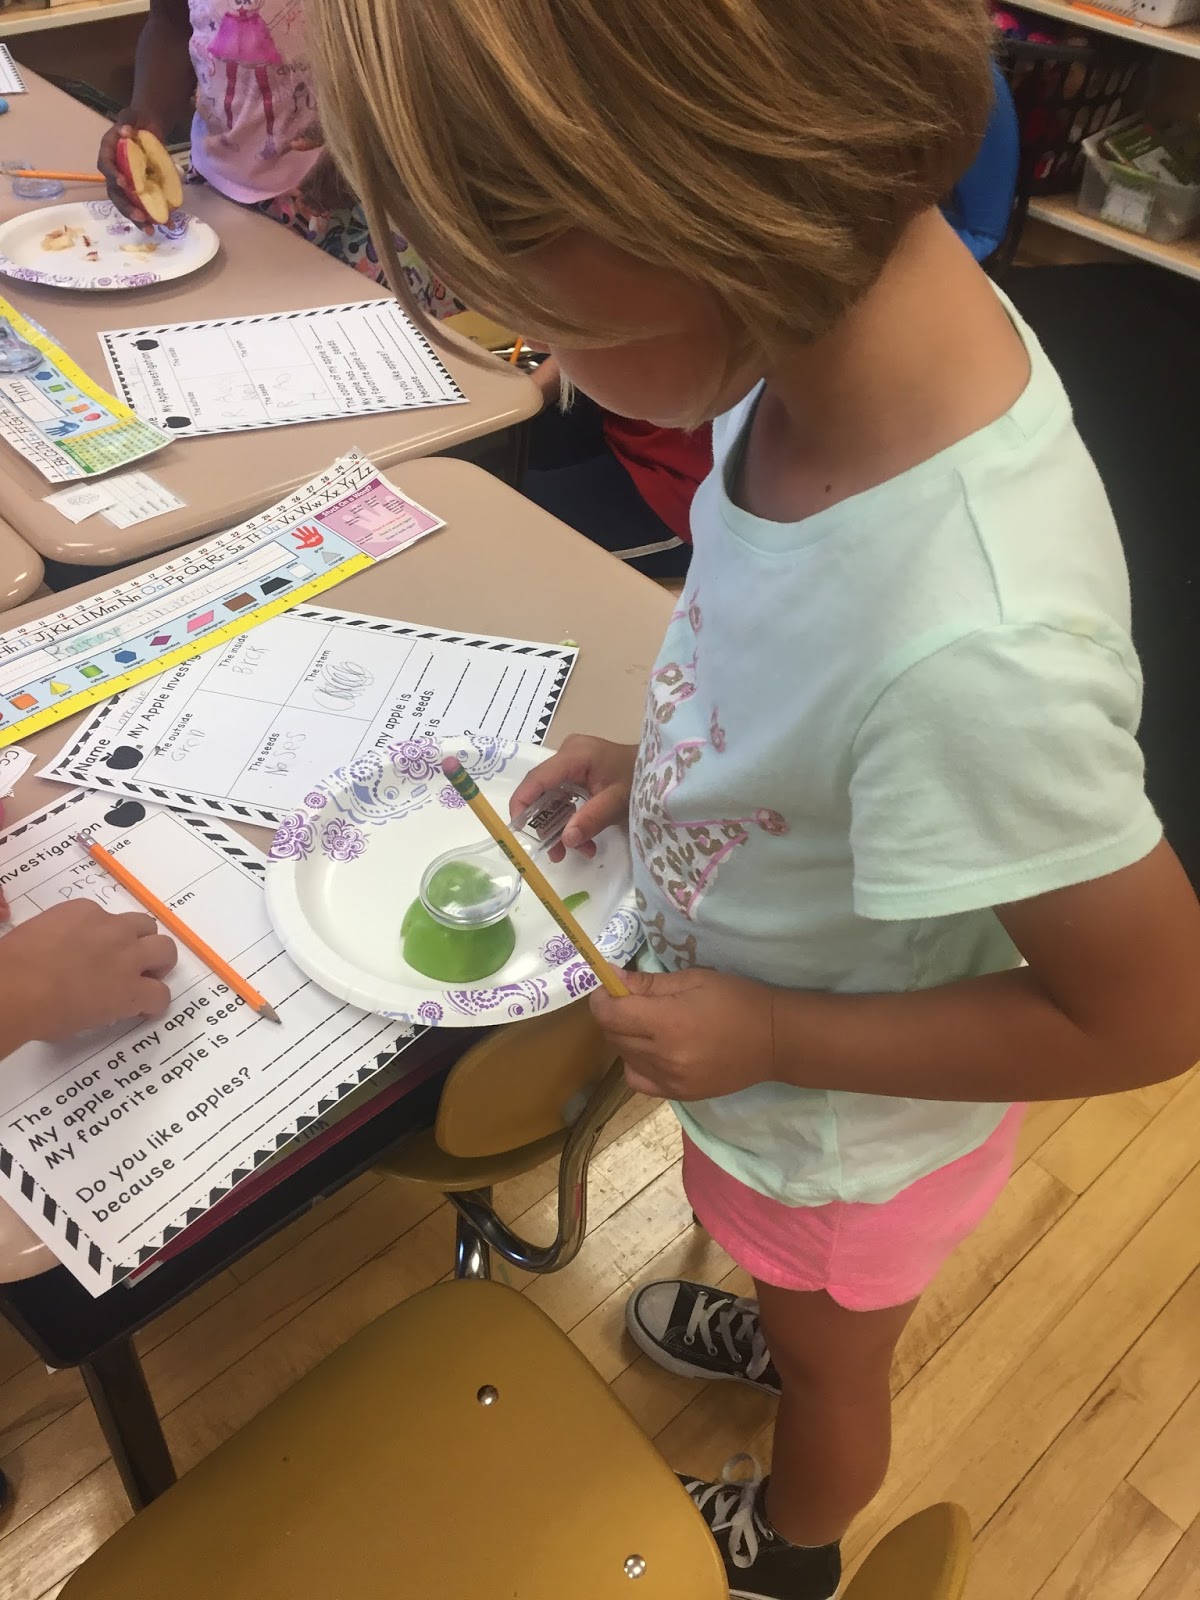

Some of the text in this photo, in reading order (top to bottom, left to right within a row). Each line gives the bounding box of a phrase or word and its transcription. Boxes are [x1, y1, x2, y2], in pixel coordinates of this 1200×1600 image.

[319, 351, 332, 365] apple
[353, 357, 367, 371] apple
[142, 352, 173, 413] My Apple Investigation
[336, 382, 350, 396] color
[346, 371, 357, 380] has
[352, 381, 367, 396] apple
[362, 371, 381, 395] favorite
[392, 370, 403, 380] like
[399, 380, 413, 391] you
[411, 376, 430, 398] because
[346, 397, 357, 408] The
[405, 391, 416, 400] Do
[306, 485, 314, 493] 27
[335, 465, 344, 473] 29
[321, 504, 338, 518] Stuck
[339, 499, 349, 508] On
[353, 485, 372, 500] Word?
[35, 631, 55, 642] Jj
[50, 625, 73, 635] Kk
[89, 605, 119, 619] Mm
[117, 595, 141, 606] Nn
[163, 575, 185, 584] Pp
[184, 564, 215, 575] Qq
[205, 554, 225, 565] Rr
[242, 532, 261, 545] Tt
[277, 515, 297, 525] Vv
[295, 502, 322, 515] Ww
[320, 490, 341, 502] Xx
[337, 478, 358, 490] Yy
[354, 466, 374, 481] Zz
[217, 634, 249, 668] The inside
[304, 649, 331, 682] The stem
[127, 655, 202, 739] My Apple Investig
[412, 688, 435, 718] seeds.
[154, 713, 193, 756] The outside
[375, 732, 394, 748] my
[385, 704, 405, 730] apple
[396, 693, 411, 704] is
[425, 718, 440, 731] is
[74, 739, 111, 772] Name
[248, 732, 280, 772] The seeds
[527, 810, 553, 829] ETA
[0, 822, 102, 885] nvestigaton
[70, 838, 131, 875] The side
[8, 984, 229, 1132] The color of my apple is
[28, 994, 246, 1152] My apple has seed
[45, 1034, 229, 1169] My favorite apple is
[75, 1066, 251, 1203] Do you like apples?
[92, 1158, 175, 1222] because
